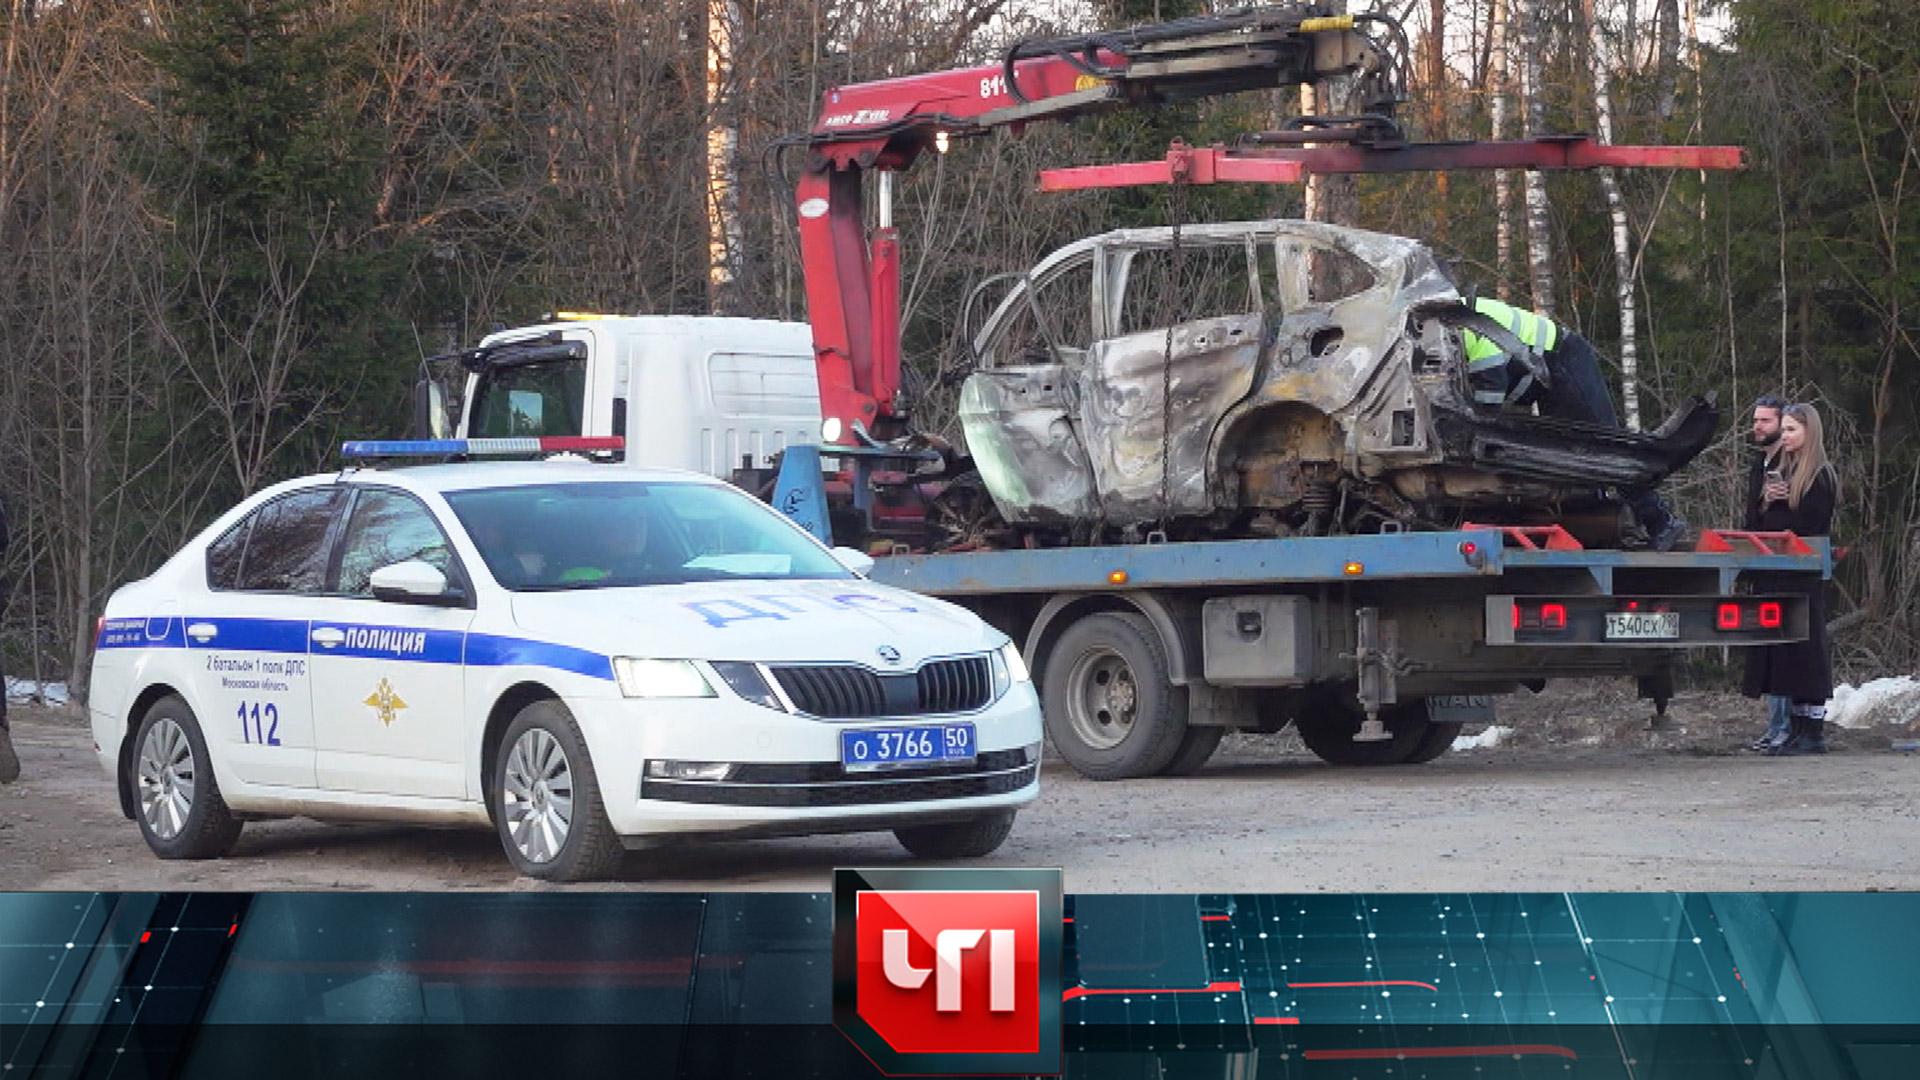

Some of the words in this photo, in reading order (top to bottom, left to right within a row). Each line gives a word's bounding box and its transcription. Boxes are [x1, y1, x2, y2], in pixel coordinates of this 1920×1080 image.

[980, 70, 1019, 98] 811
[345, 627, 427, 656] ПОЛИЦИЯ
[207, 655, 212, 671] 2
[213, 655, 254, 671] батальон
[256, 657, 260, 673] 1
[262, 662, 283, 673] полк
[285, 660, 305, 676] ДПС
[222, 677, 260, 688] Московская
[261, 678, 288, 691] область
[237, 700, 281, 747] 112
[945, 728, 968, 747] 50
[877, 730, 933, 759] 3766
